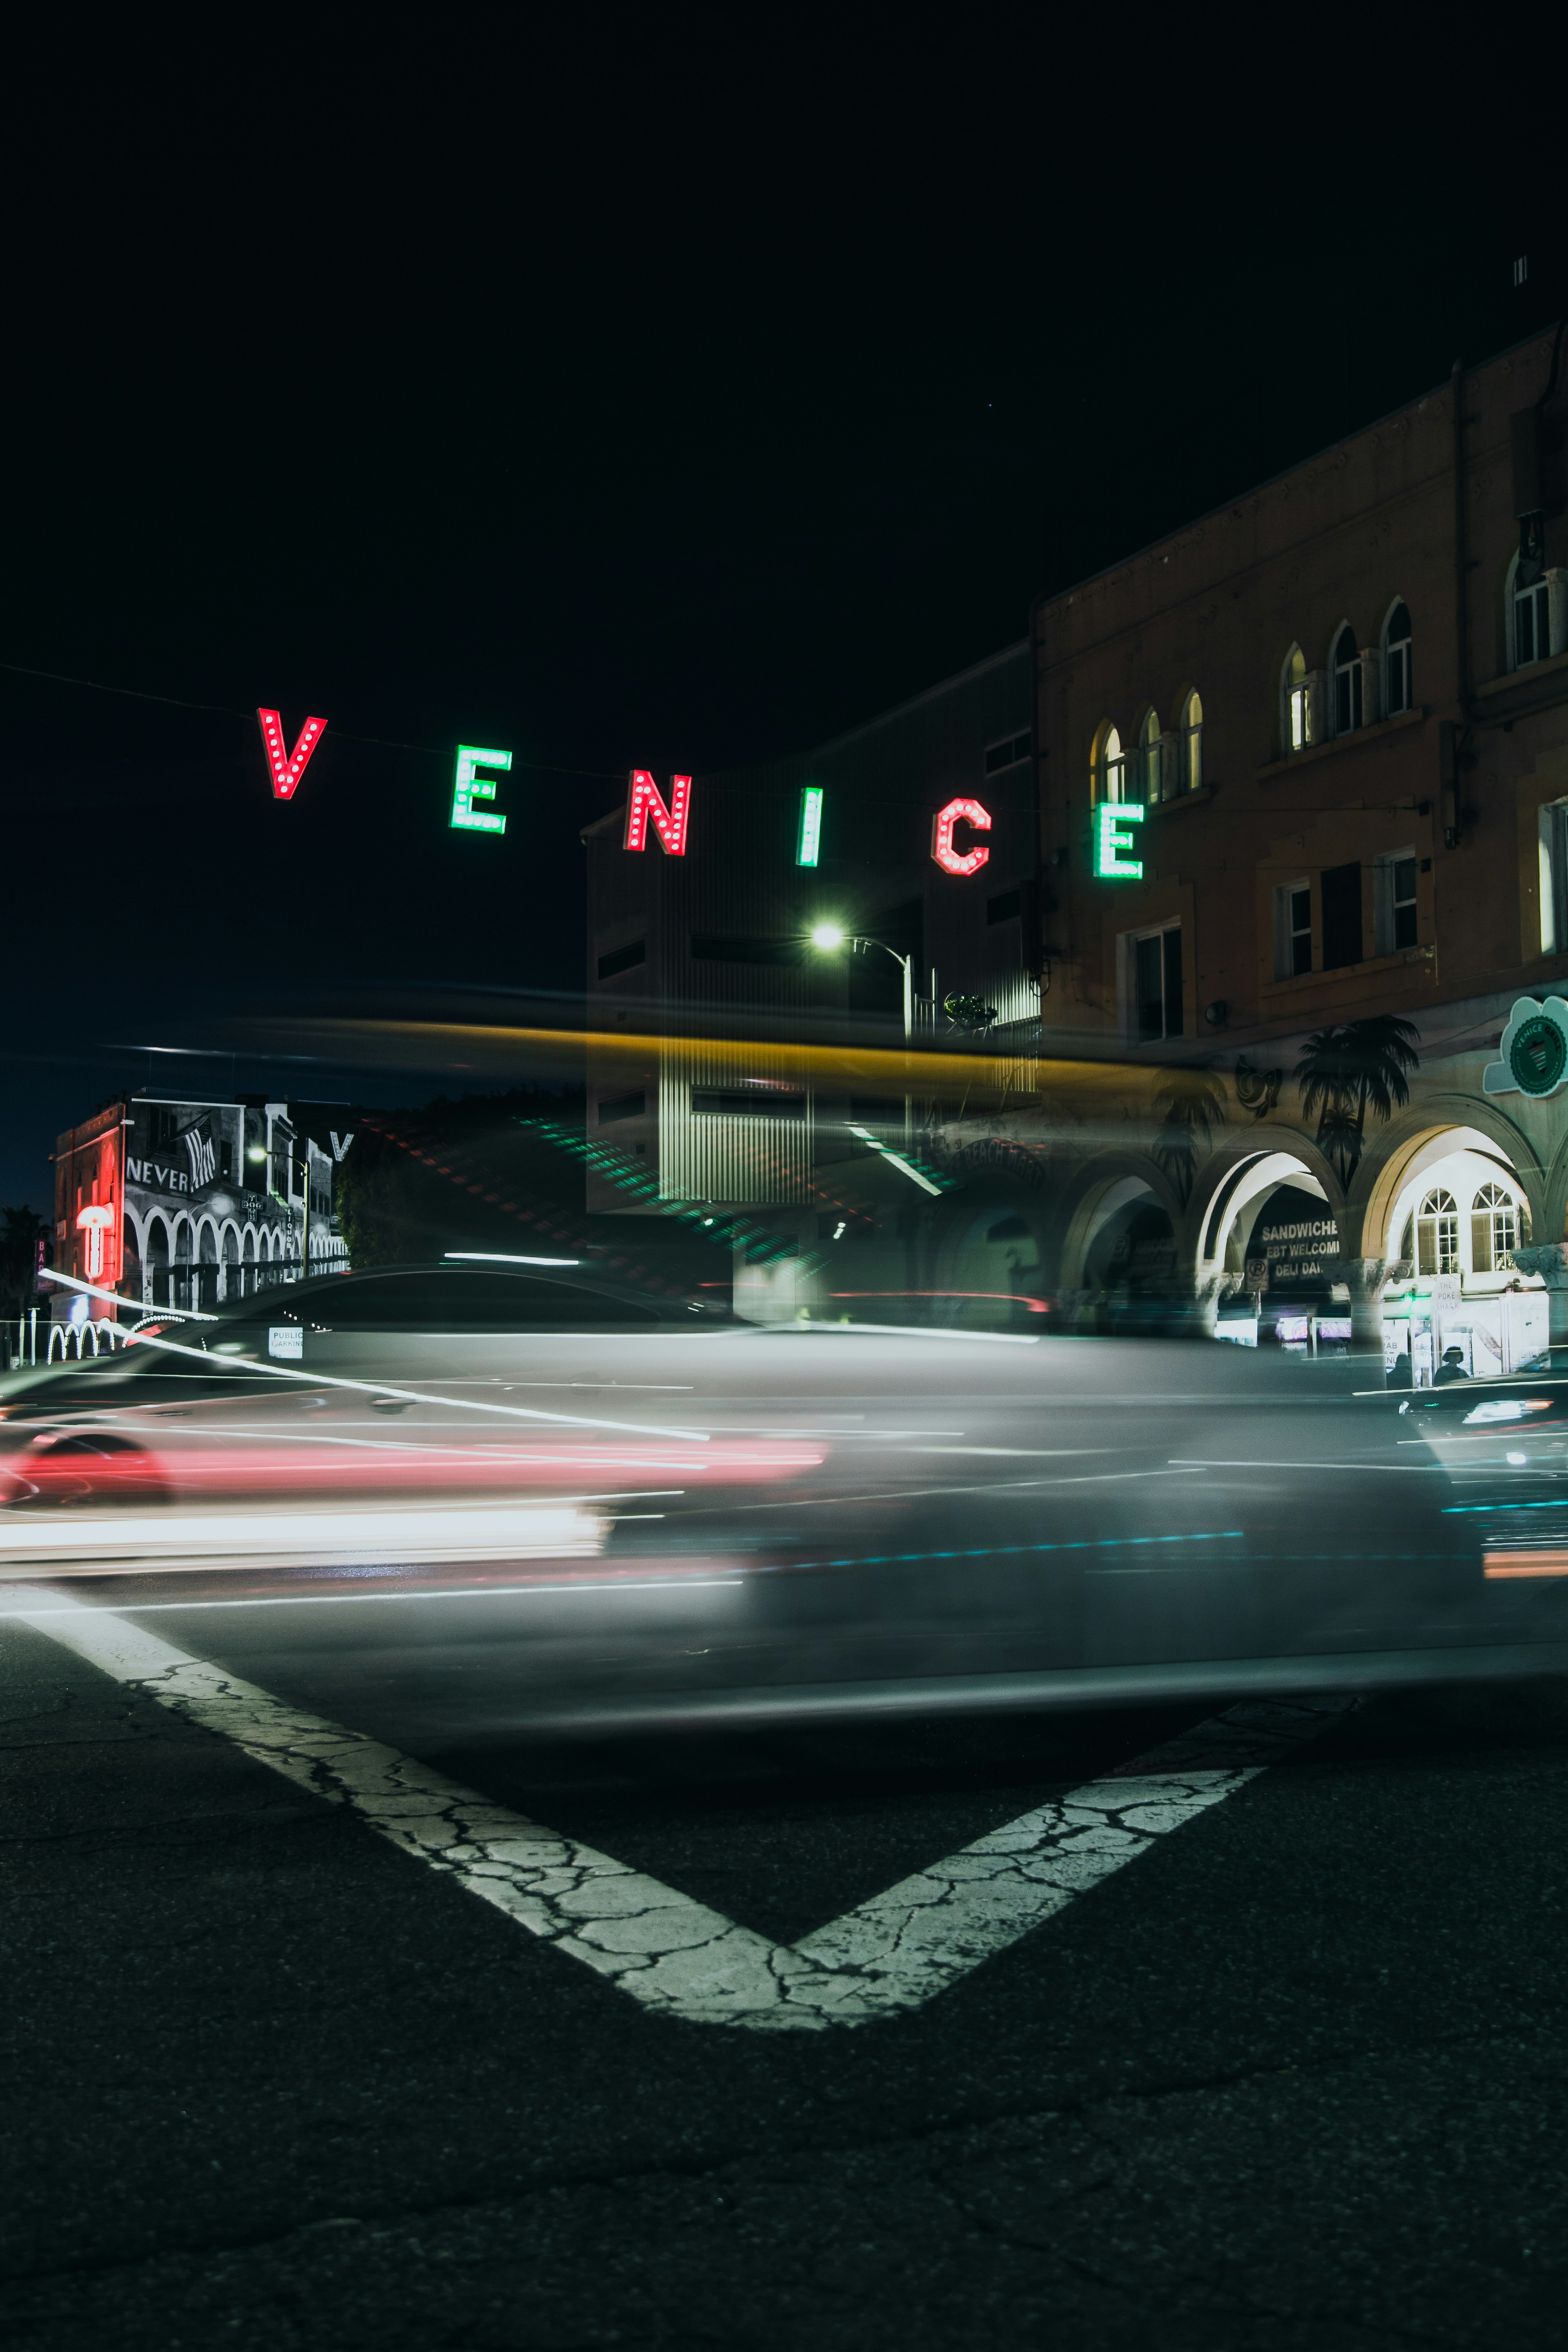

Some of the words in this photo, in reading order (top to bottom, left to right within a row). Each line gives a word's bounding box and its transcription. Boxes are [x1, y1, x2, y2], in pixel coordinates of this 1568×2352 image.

[256, 708, 1145, 880] VENICE
[1516, 1024, 1542, 1048] VENICE
[1545, 1026, 1561, 1053] GRILL
[964, 1138, 1003, 1170] BEACH
[126, 1157, 189, 1193] NEVER
[1266, 1245, 1288, 1258] EBT
[1276, 1263, 1298, 1277] DELI
